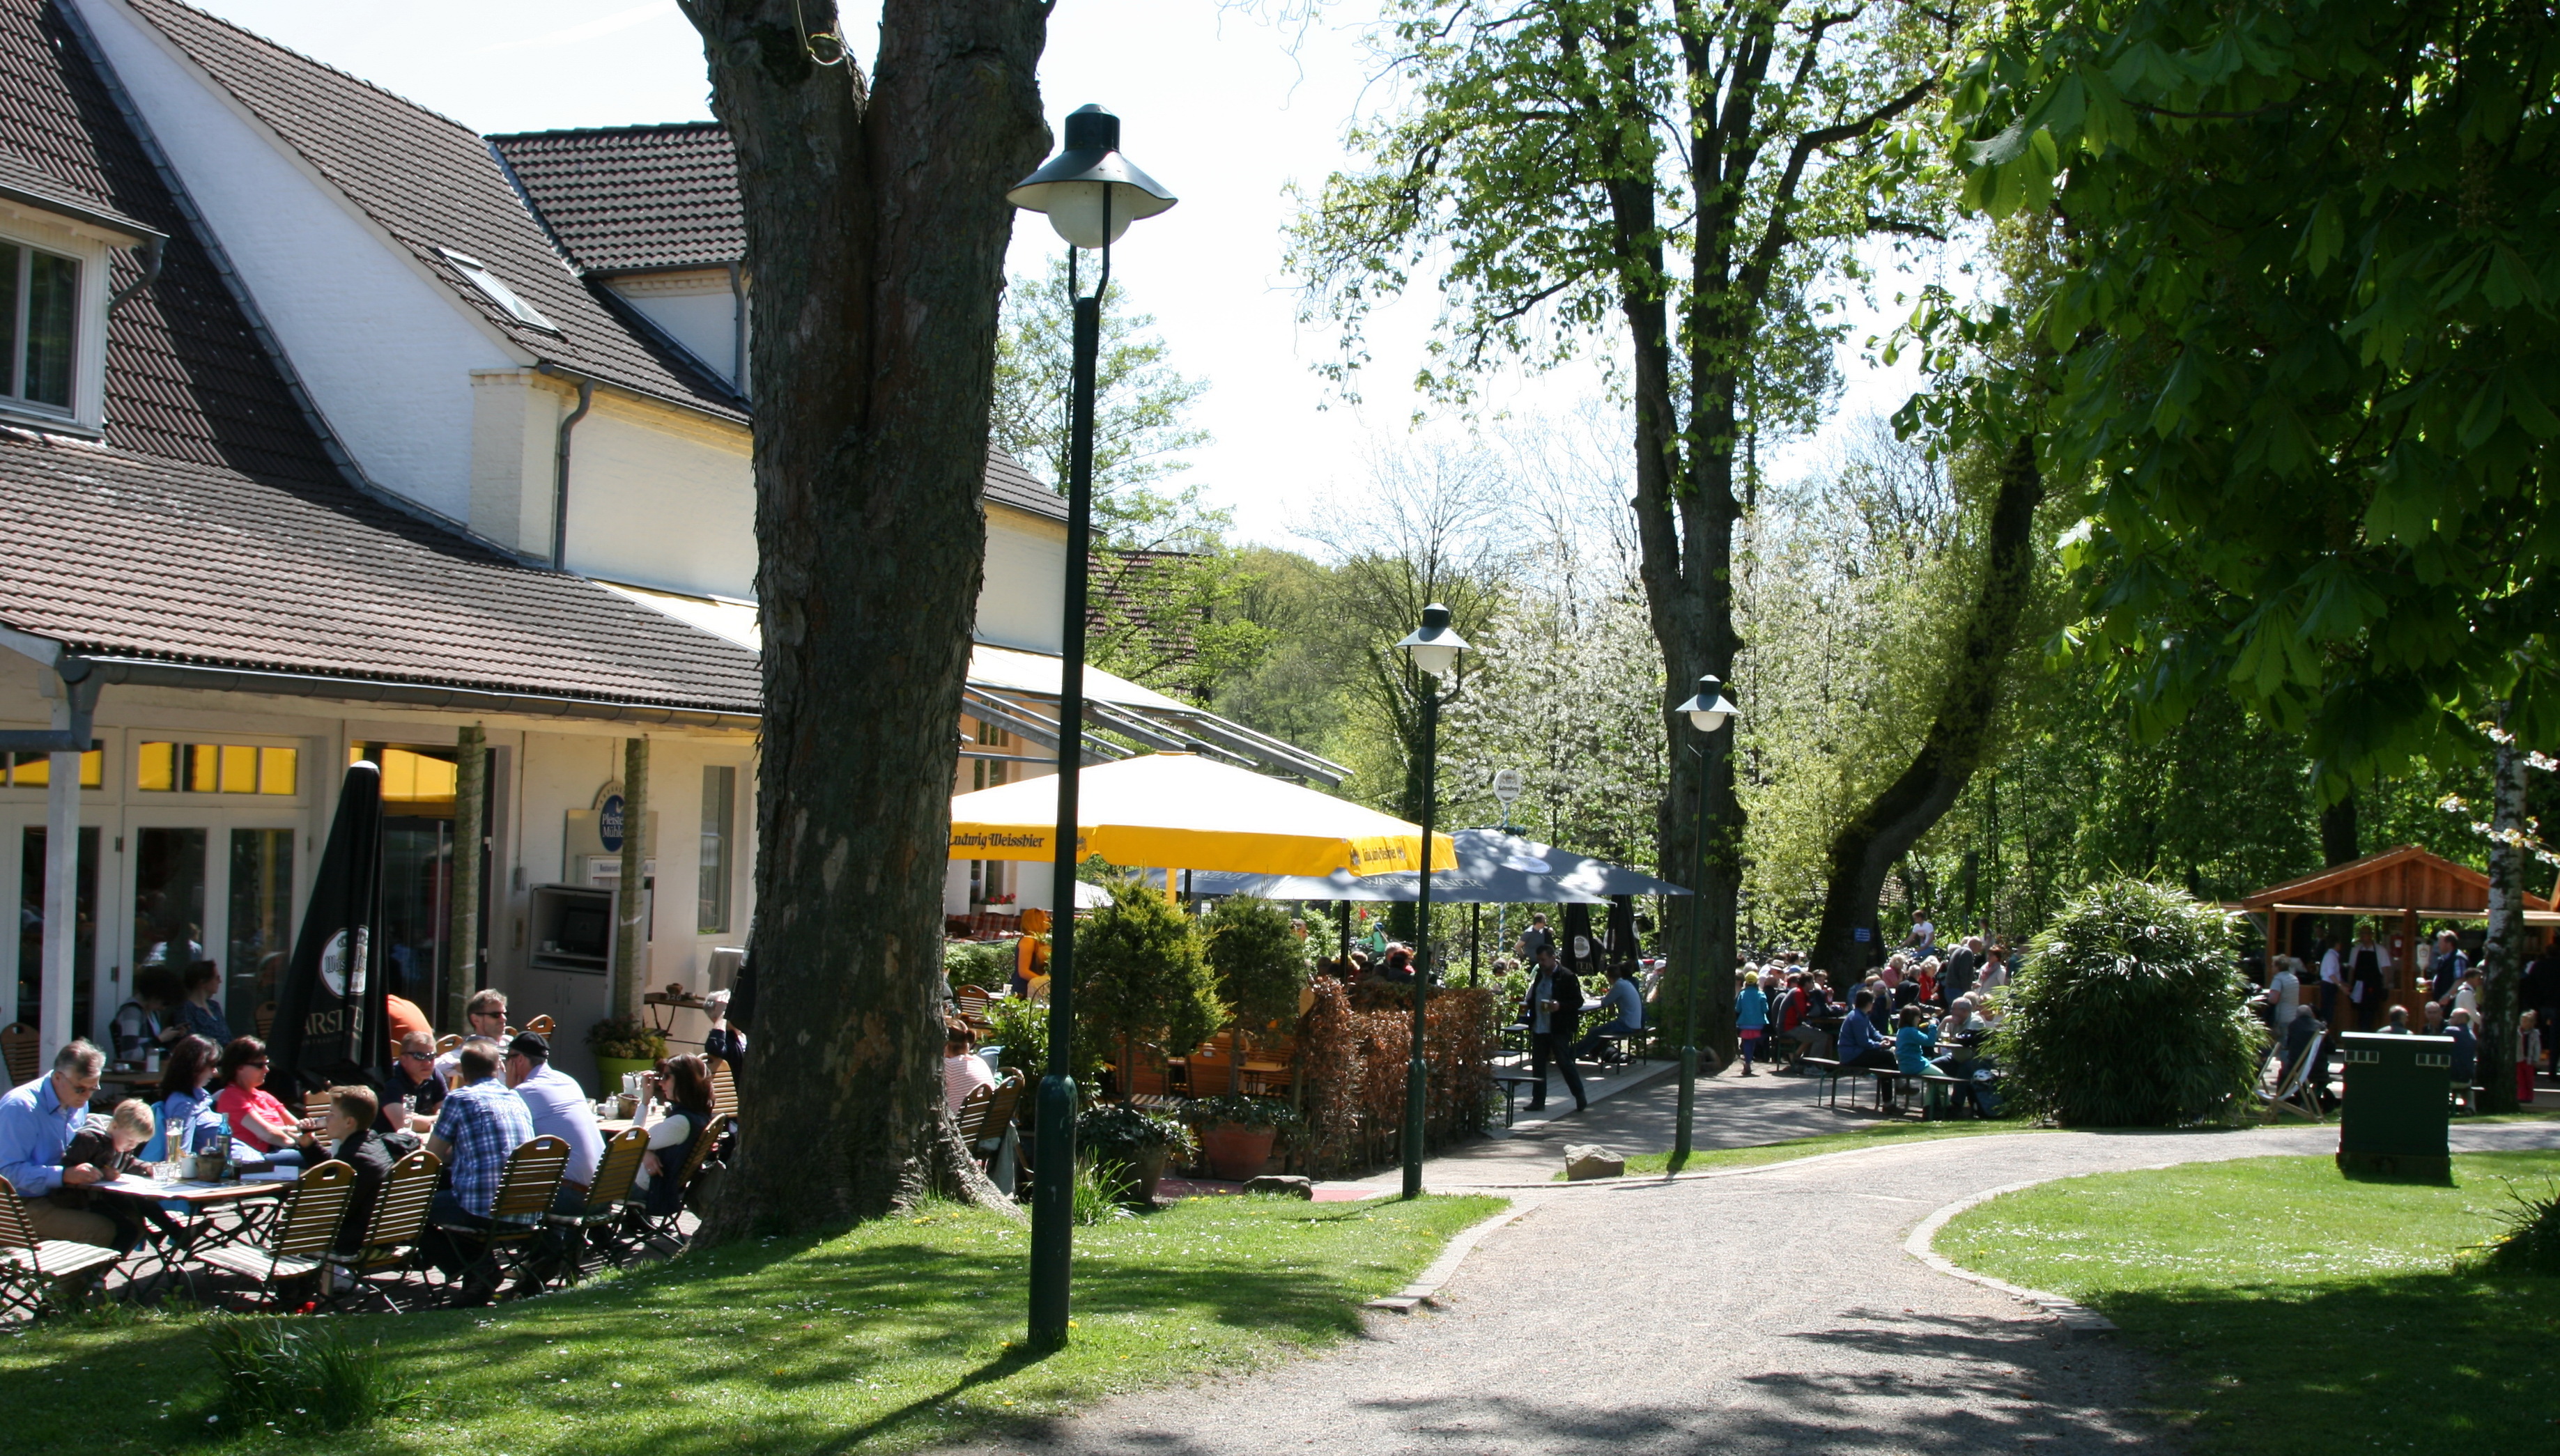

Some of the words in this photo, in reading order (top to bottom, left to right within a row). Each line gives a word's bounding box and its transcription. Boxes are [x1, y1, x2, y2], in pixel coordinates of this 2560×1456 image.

[602, 812, 624, 825] Pleiste
[602, 826, 624, 837] Mühle
[988, 832, 1044, 848] Weissbier
